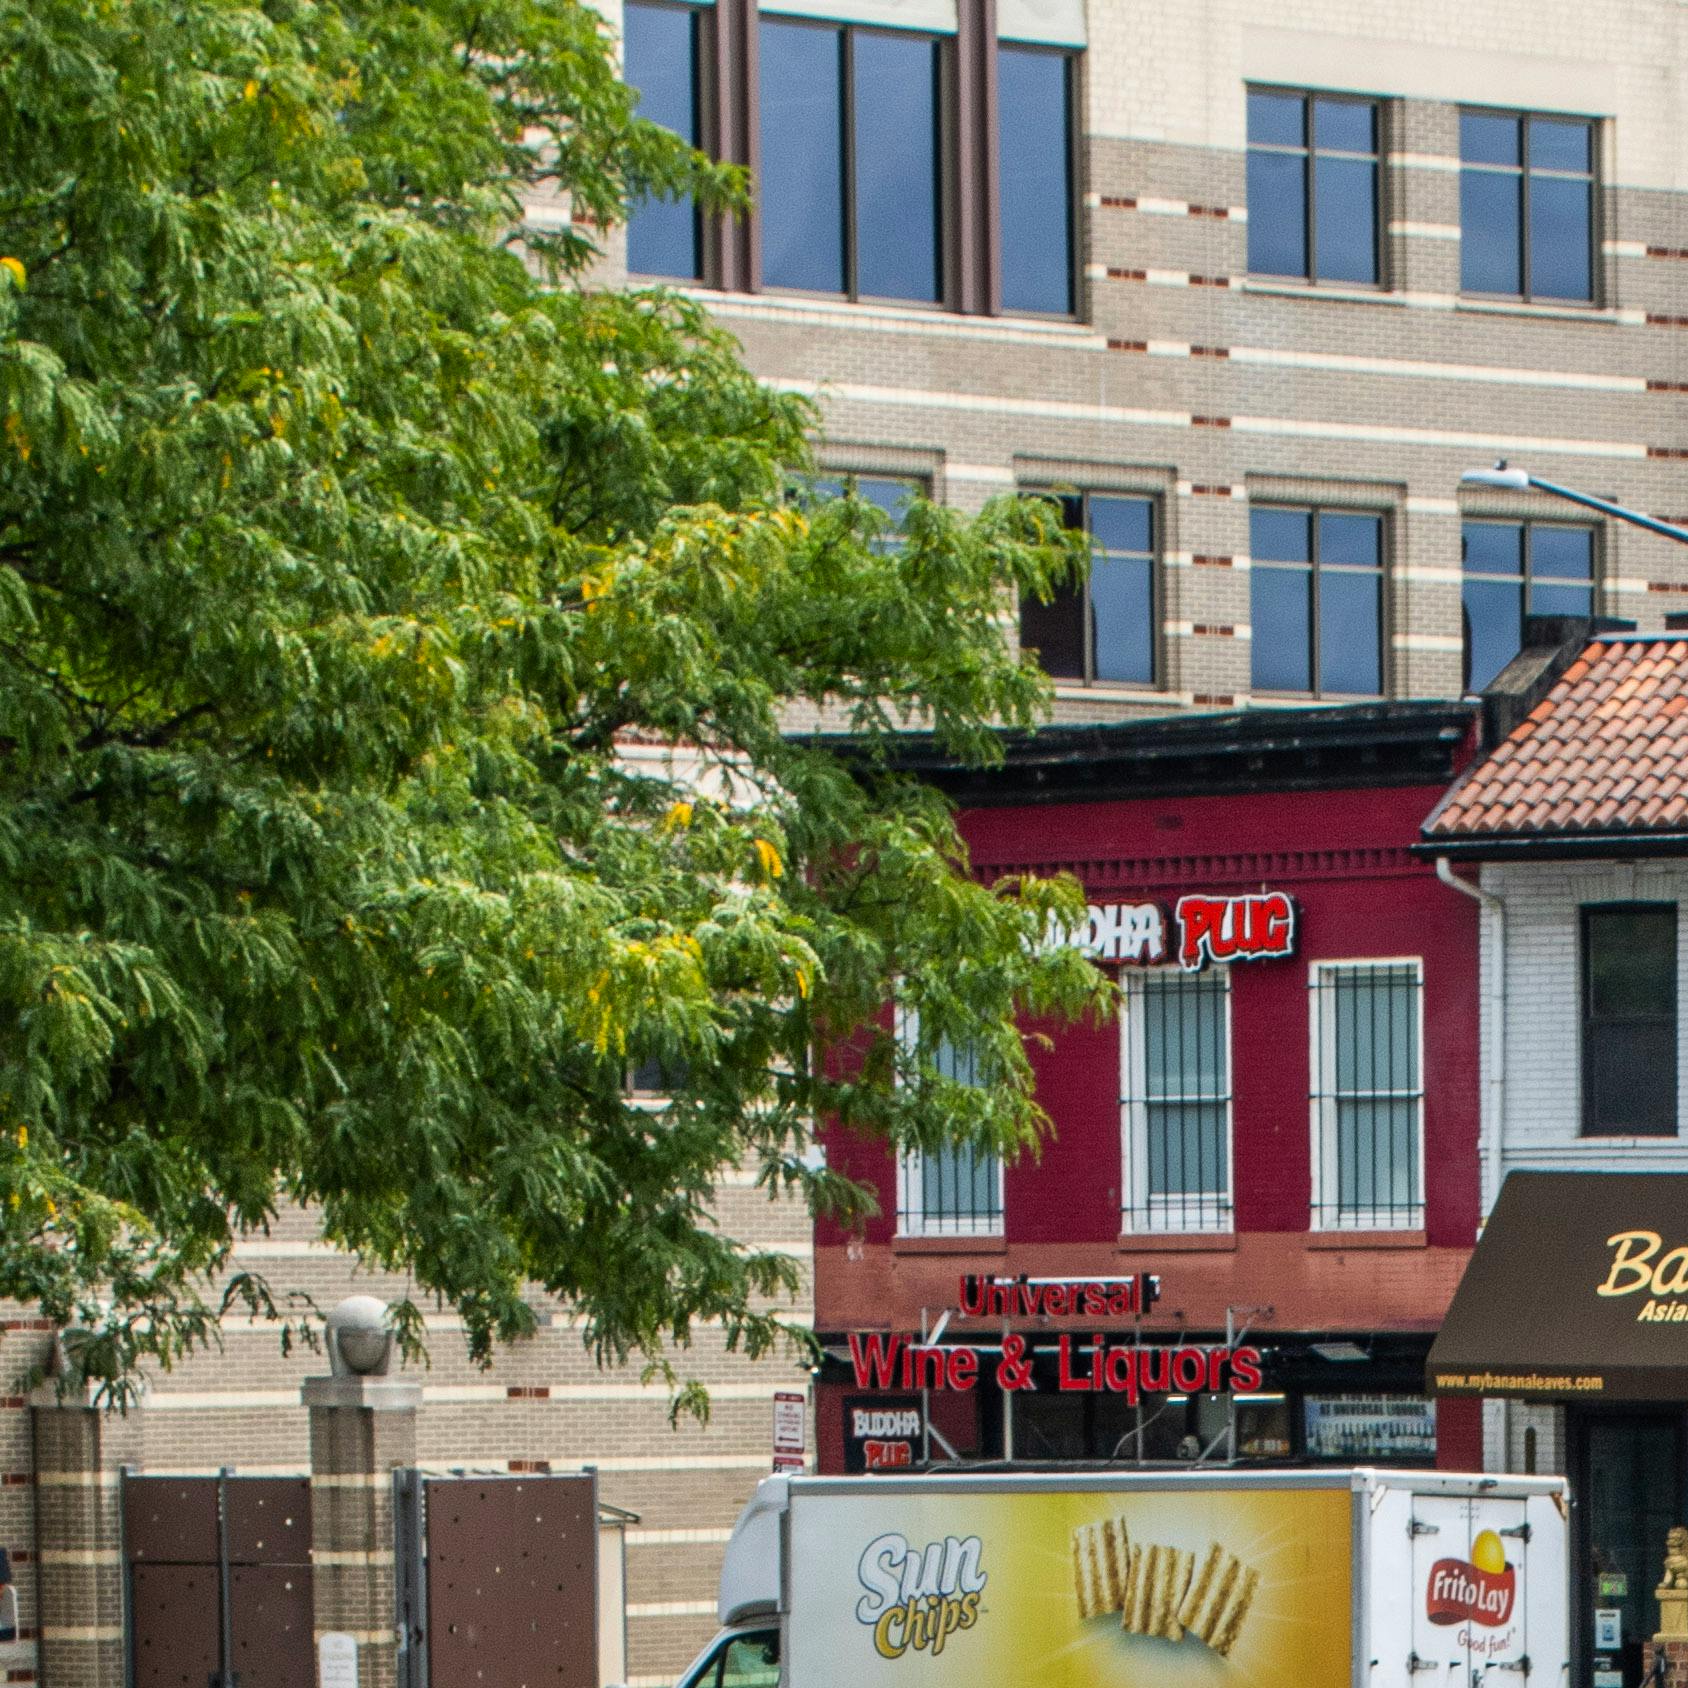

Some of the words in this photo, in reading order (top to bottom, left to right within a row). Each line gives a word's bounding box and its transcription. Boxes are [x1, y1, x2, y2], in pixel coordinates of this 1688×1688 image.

[1175, 892, 1293, 971] PLUG
[959, 1274, 1142, 1316] Universal
[848, 1334, 978, 1391] Wine
[996, 1334, 1038, 1391] &
[1059, 1334, 1262, 1407] Liquors
[1435, 1373, 1604, 1391] www.mybananaleaves.com
[853, 1409, 920, 1437] BUDDHA
[856, 1533, 988, 1625] Sun
[874, 1592, 981, 1660] Chips
[1458, 1629, 1486, 1653] Good
